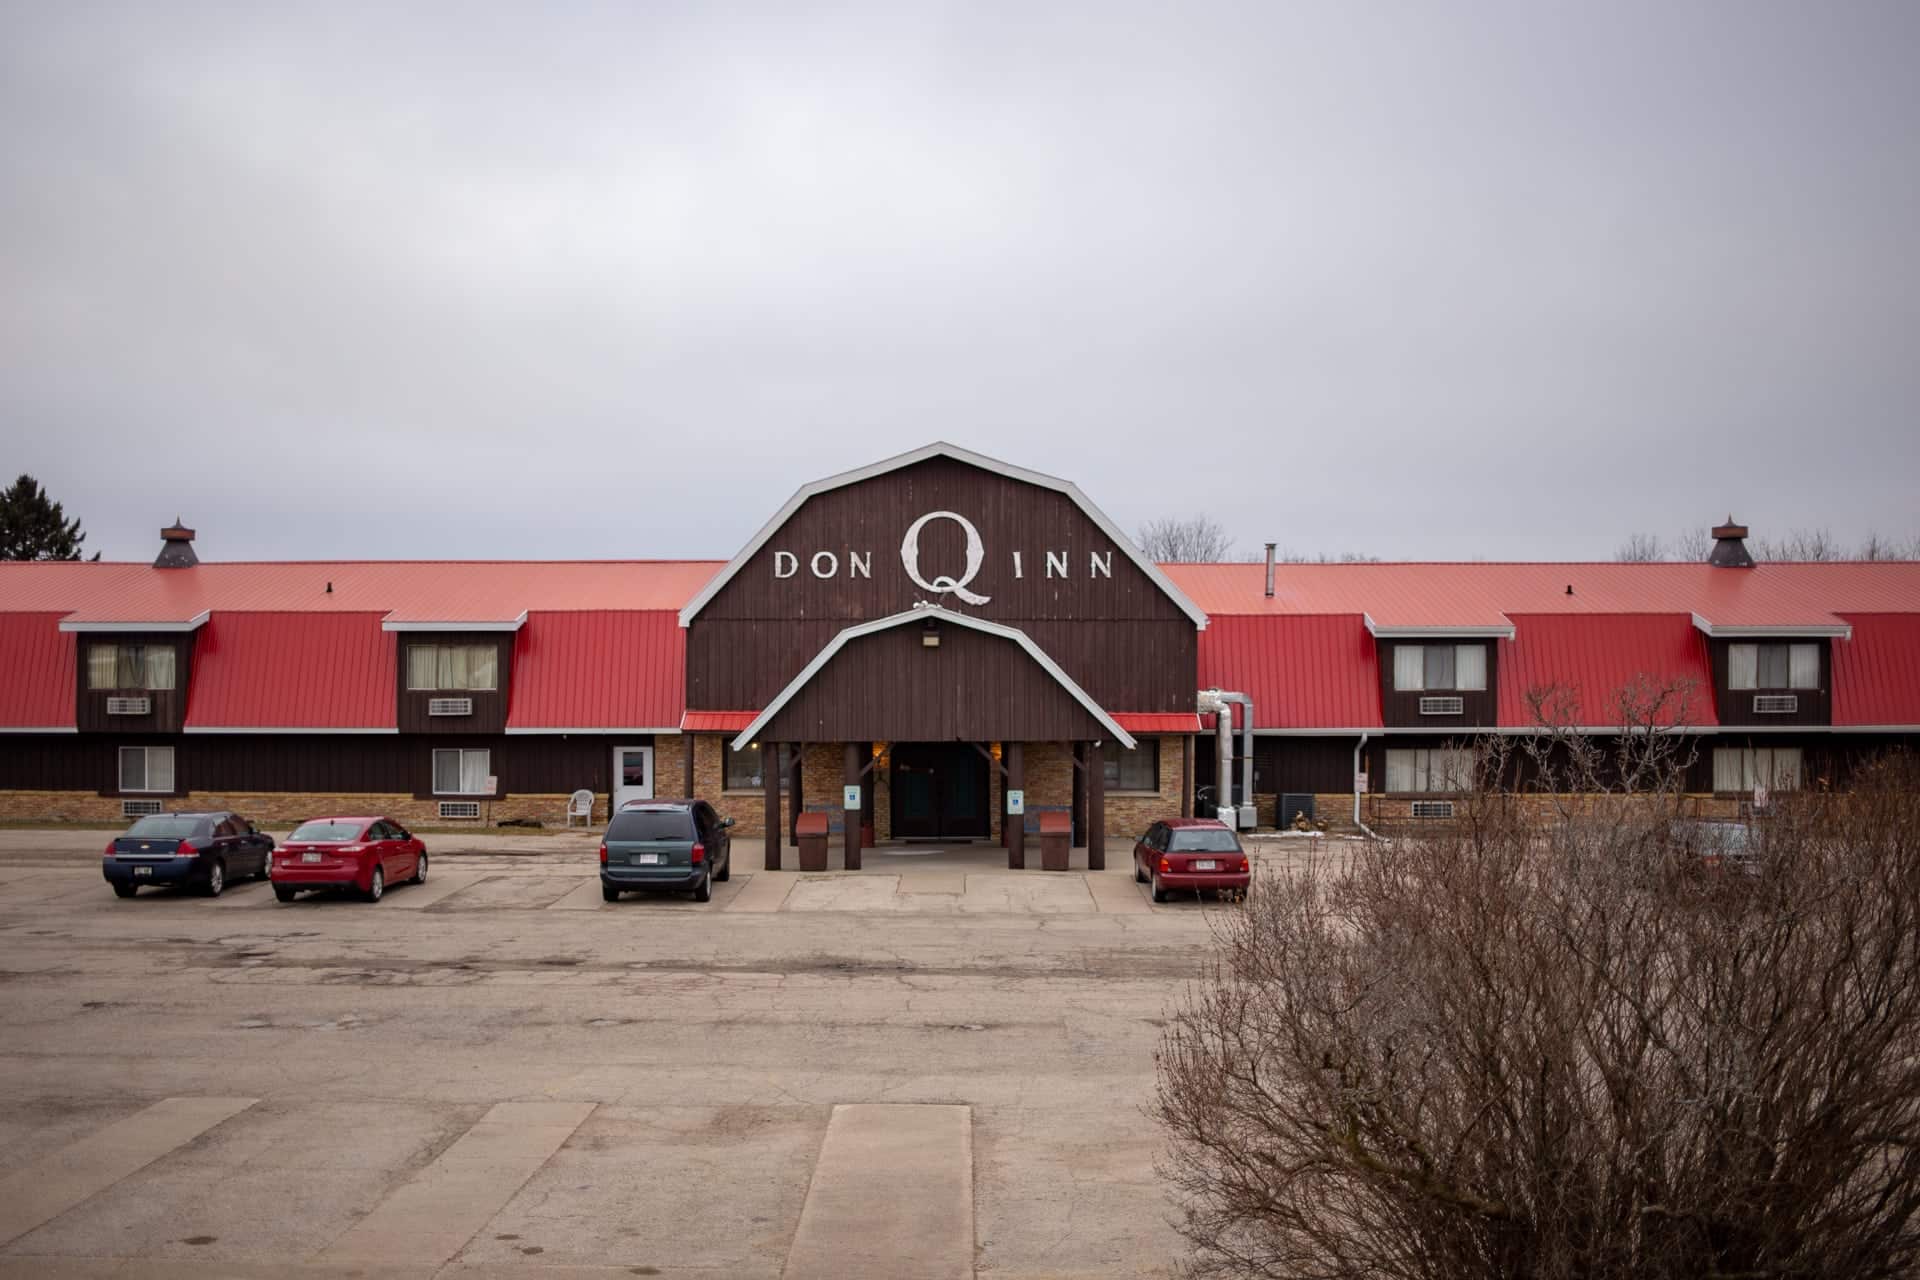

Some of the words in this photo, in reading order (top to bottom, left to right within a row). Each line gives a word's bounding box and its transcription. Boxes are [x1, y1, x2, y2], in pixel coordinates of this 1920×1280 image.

[774, 551, 872, 579] DON
[900, 510, 992, 606] Q
[1012, 551, 1113, 579] INN
